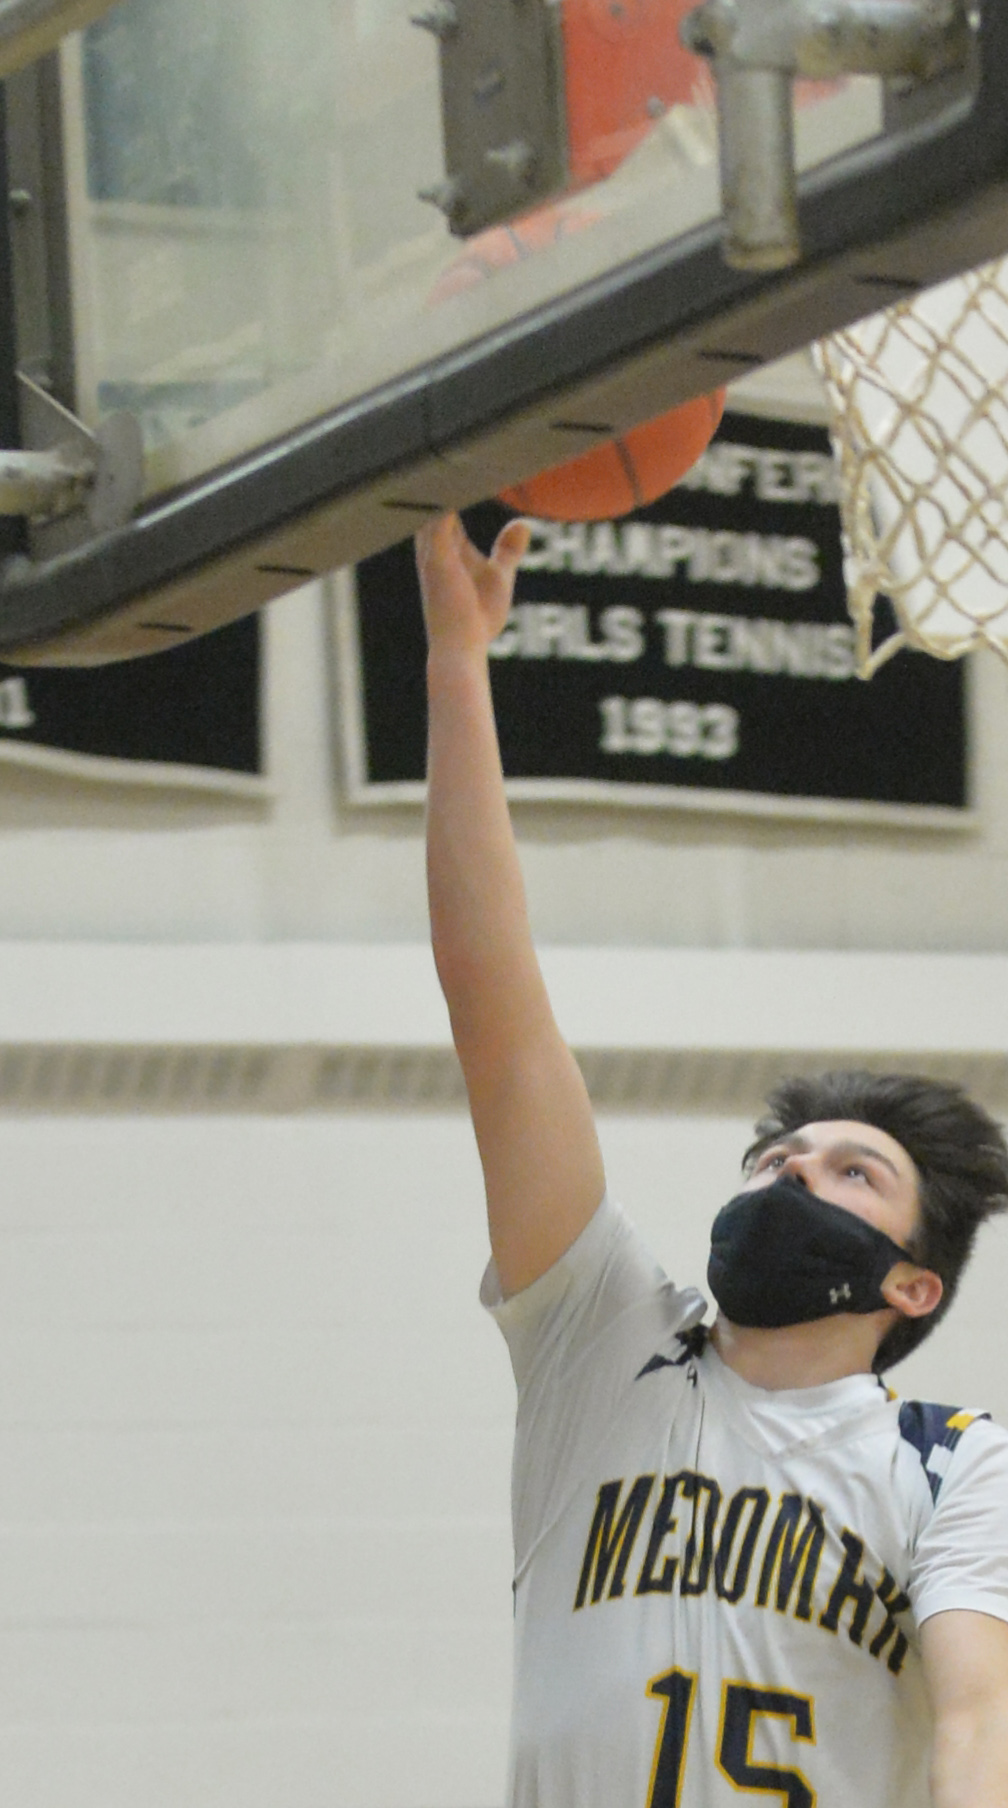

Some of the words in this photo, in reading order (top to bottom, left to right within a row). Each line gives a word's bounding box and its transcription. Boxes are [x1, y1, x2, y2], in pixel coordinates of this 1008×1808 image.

[519, 517, 822, 590] CHAMPIONS
[655, 608, 858, 680] TENNIS
[600, 697, 740, 760] 1993
